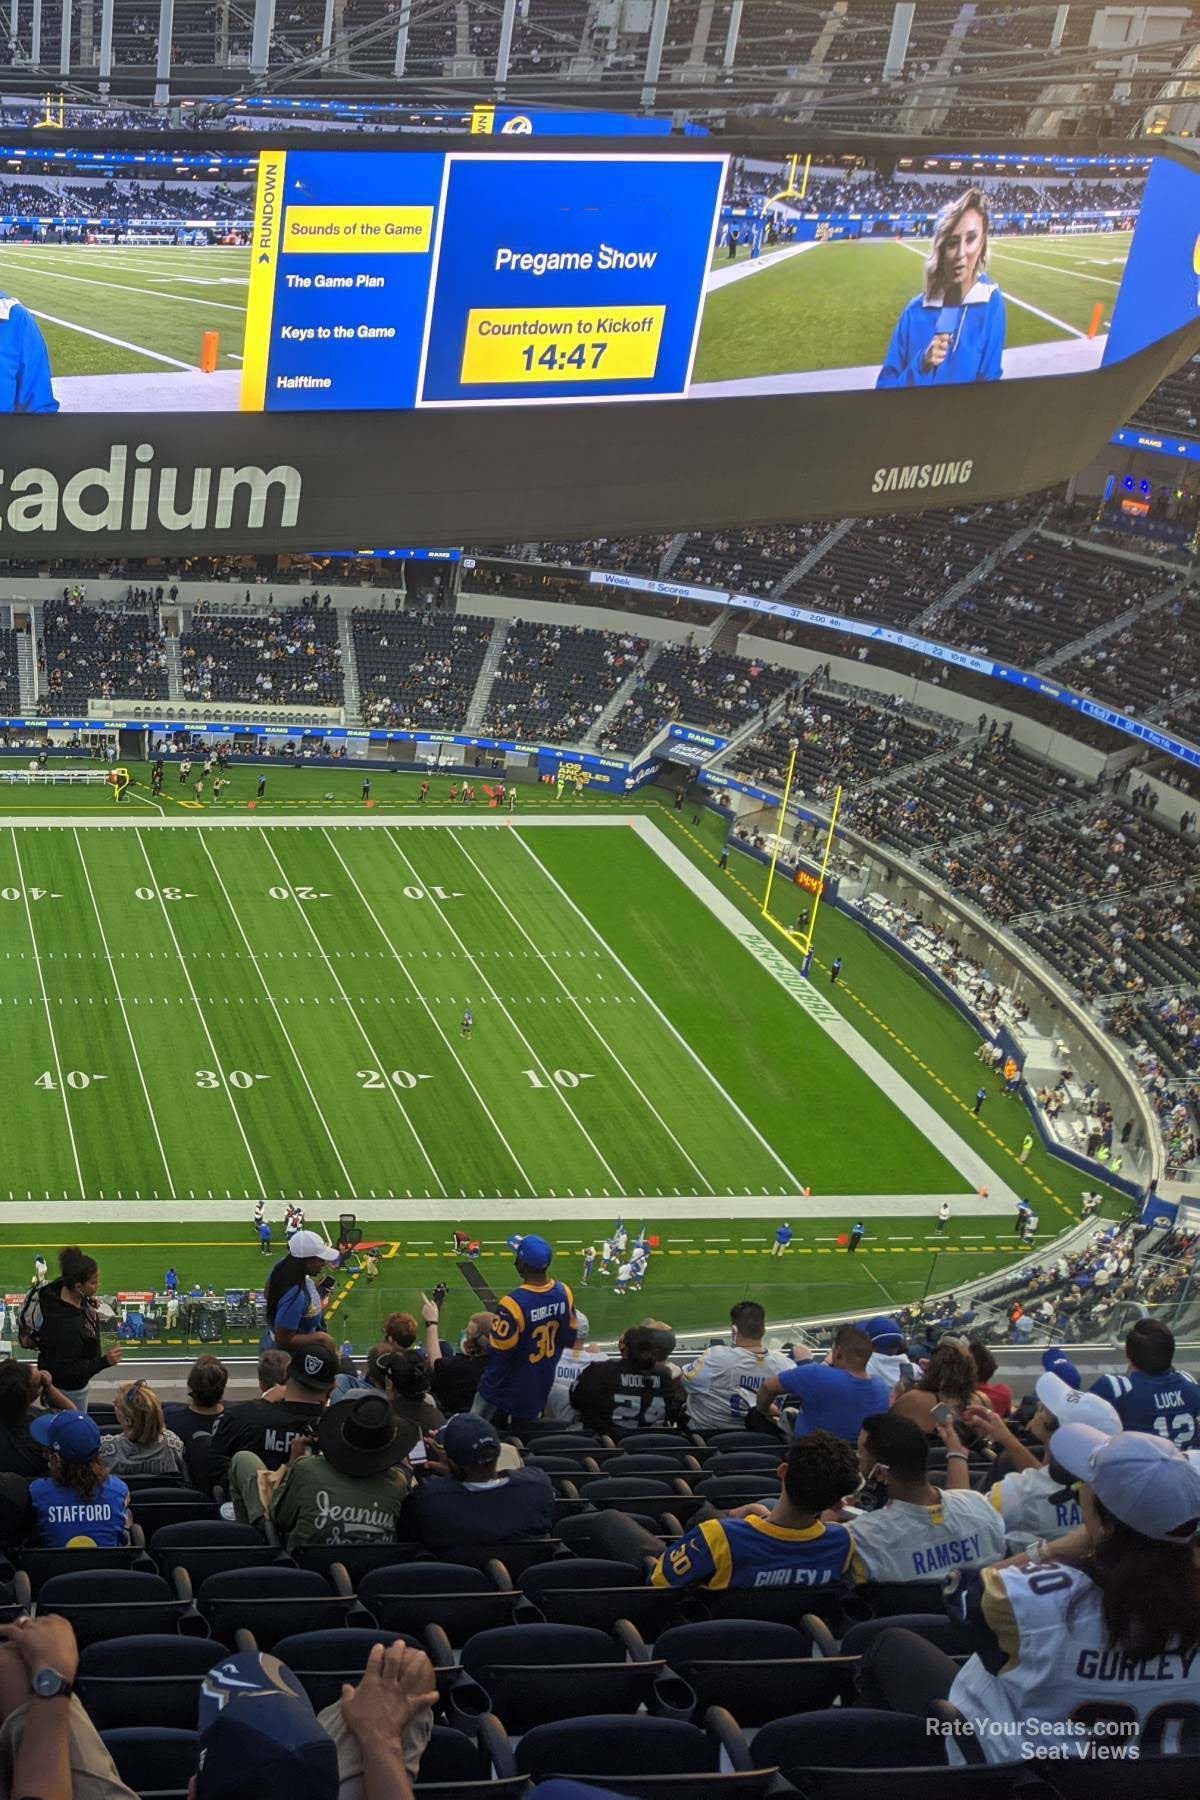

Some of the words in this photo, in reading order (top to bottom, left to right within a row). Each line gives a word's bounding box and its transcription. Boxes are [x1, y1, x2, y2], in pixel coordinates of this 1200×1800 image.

[259, 163, 278, 249] RUNDOWN
[290, 222, 340, 236] Sounds
[343, 222, 358, 236] of
[360, 223, 381, 236] the
[384, 223, 423, 236] Game
[494, 248, 593, 276] Pregame
[597, 248, 658, 270] Show
[285, 274, 311, 288] The
[314, 274, 354, 288] Game
[356, 274, 385, 288] Plan
[281, 326, 315, 342] Keys
[317, 326, 331, 338] to
[333, 326, 355, 338] the
[357, 325, 396, 338] Game
[477, 319, 573, 336] Countdown
[577, 320, 593, 335] to
[596, 317, 653, 334] Kickoff
[522, 342, 608, 371] 14:47
[276, 375, 332, 389] Halftime
[871, 459, 974, 494] SAMSUNG
[605, 574, 631, 586] Week
[657, 583, 690, 596] Scores
[687, 732, 716, 746] RAMS
[346, 730, 371, 738] RAMS
[514, 744, 540, 754] RAMS
[600, 758, 625, 769] RAMS
[669, 748, 707, 761] Stadium
[557, 767, 611, 783] ANGELES
[559, 761, 583, 772] LOS
[1, 887, 48, 901] 40
[134, 886, 183, 901] 30
[268, 885, 319, 901] 20
[402, 885, 452, 901] 10
[34, 1071, 90, 1090] 40
[195, 1070, 253, 1089] 30
[356, 1070, 418, 1089] 20
[521, 1069, 580, 1089] 10
[530, 1303, 560, 1323] GURLEY
[528, 1320, 561, 1364] 30
[557, 1366, 583, 1380] DONA
[740, 1375, 767, 1389] DONA
[1153, 1390, 1185, 1409] LUCK
[1153, 1412, 1196, 1449] 12
[264, 1428, 300, 1453] McF
[47, 1503, 112, 1524] STAFFORD
[314, 1490, 396, 1530] Jeanius
[668, 1542, 694, 1576] 30
[912, 1534, 983, 1576] RAMSEY
[1076, 1649, 1199, 1682] GURLEY
